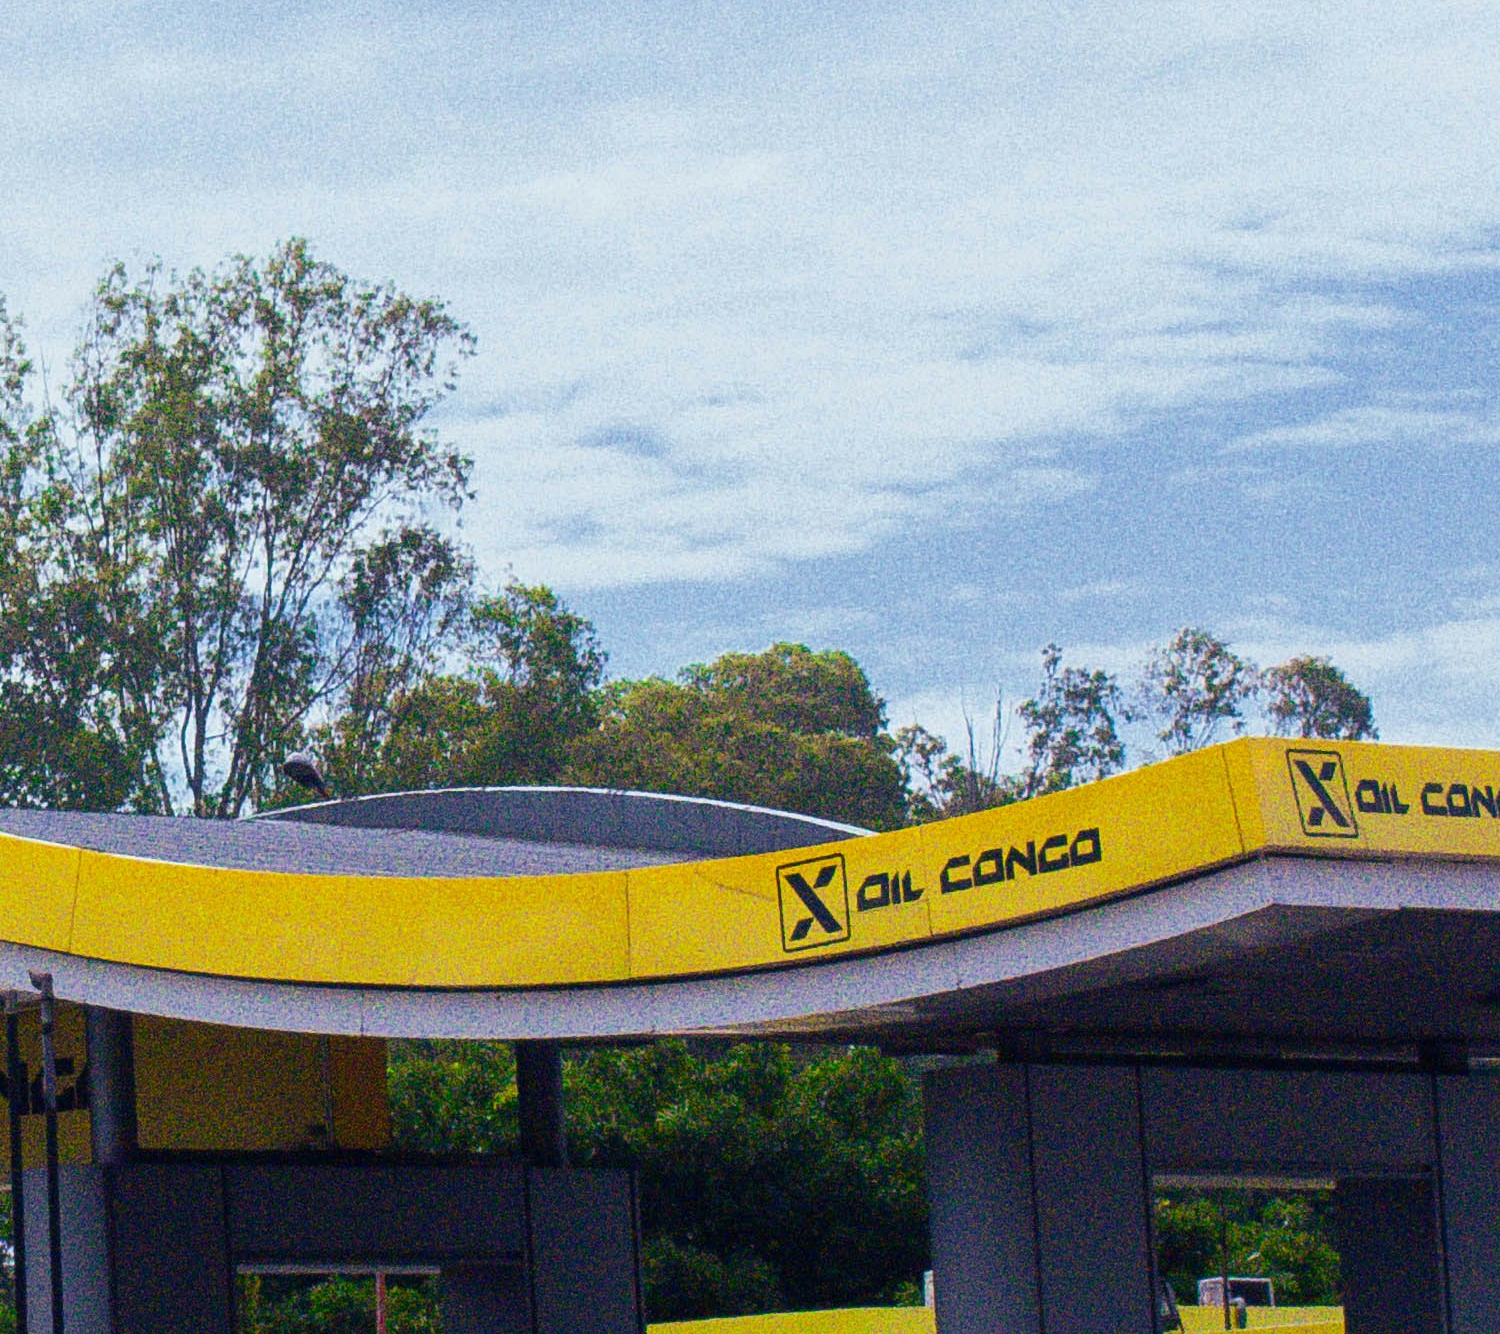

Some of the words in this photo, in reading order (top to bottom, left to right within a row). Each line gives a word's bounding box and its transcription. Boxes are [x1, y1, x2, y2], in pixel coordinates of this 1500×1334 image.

[1355, 778, 1411, 815] OIL
[856, 869, 925, 912] OIL
[939, 827, 1102, 895] CONGO
